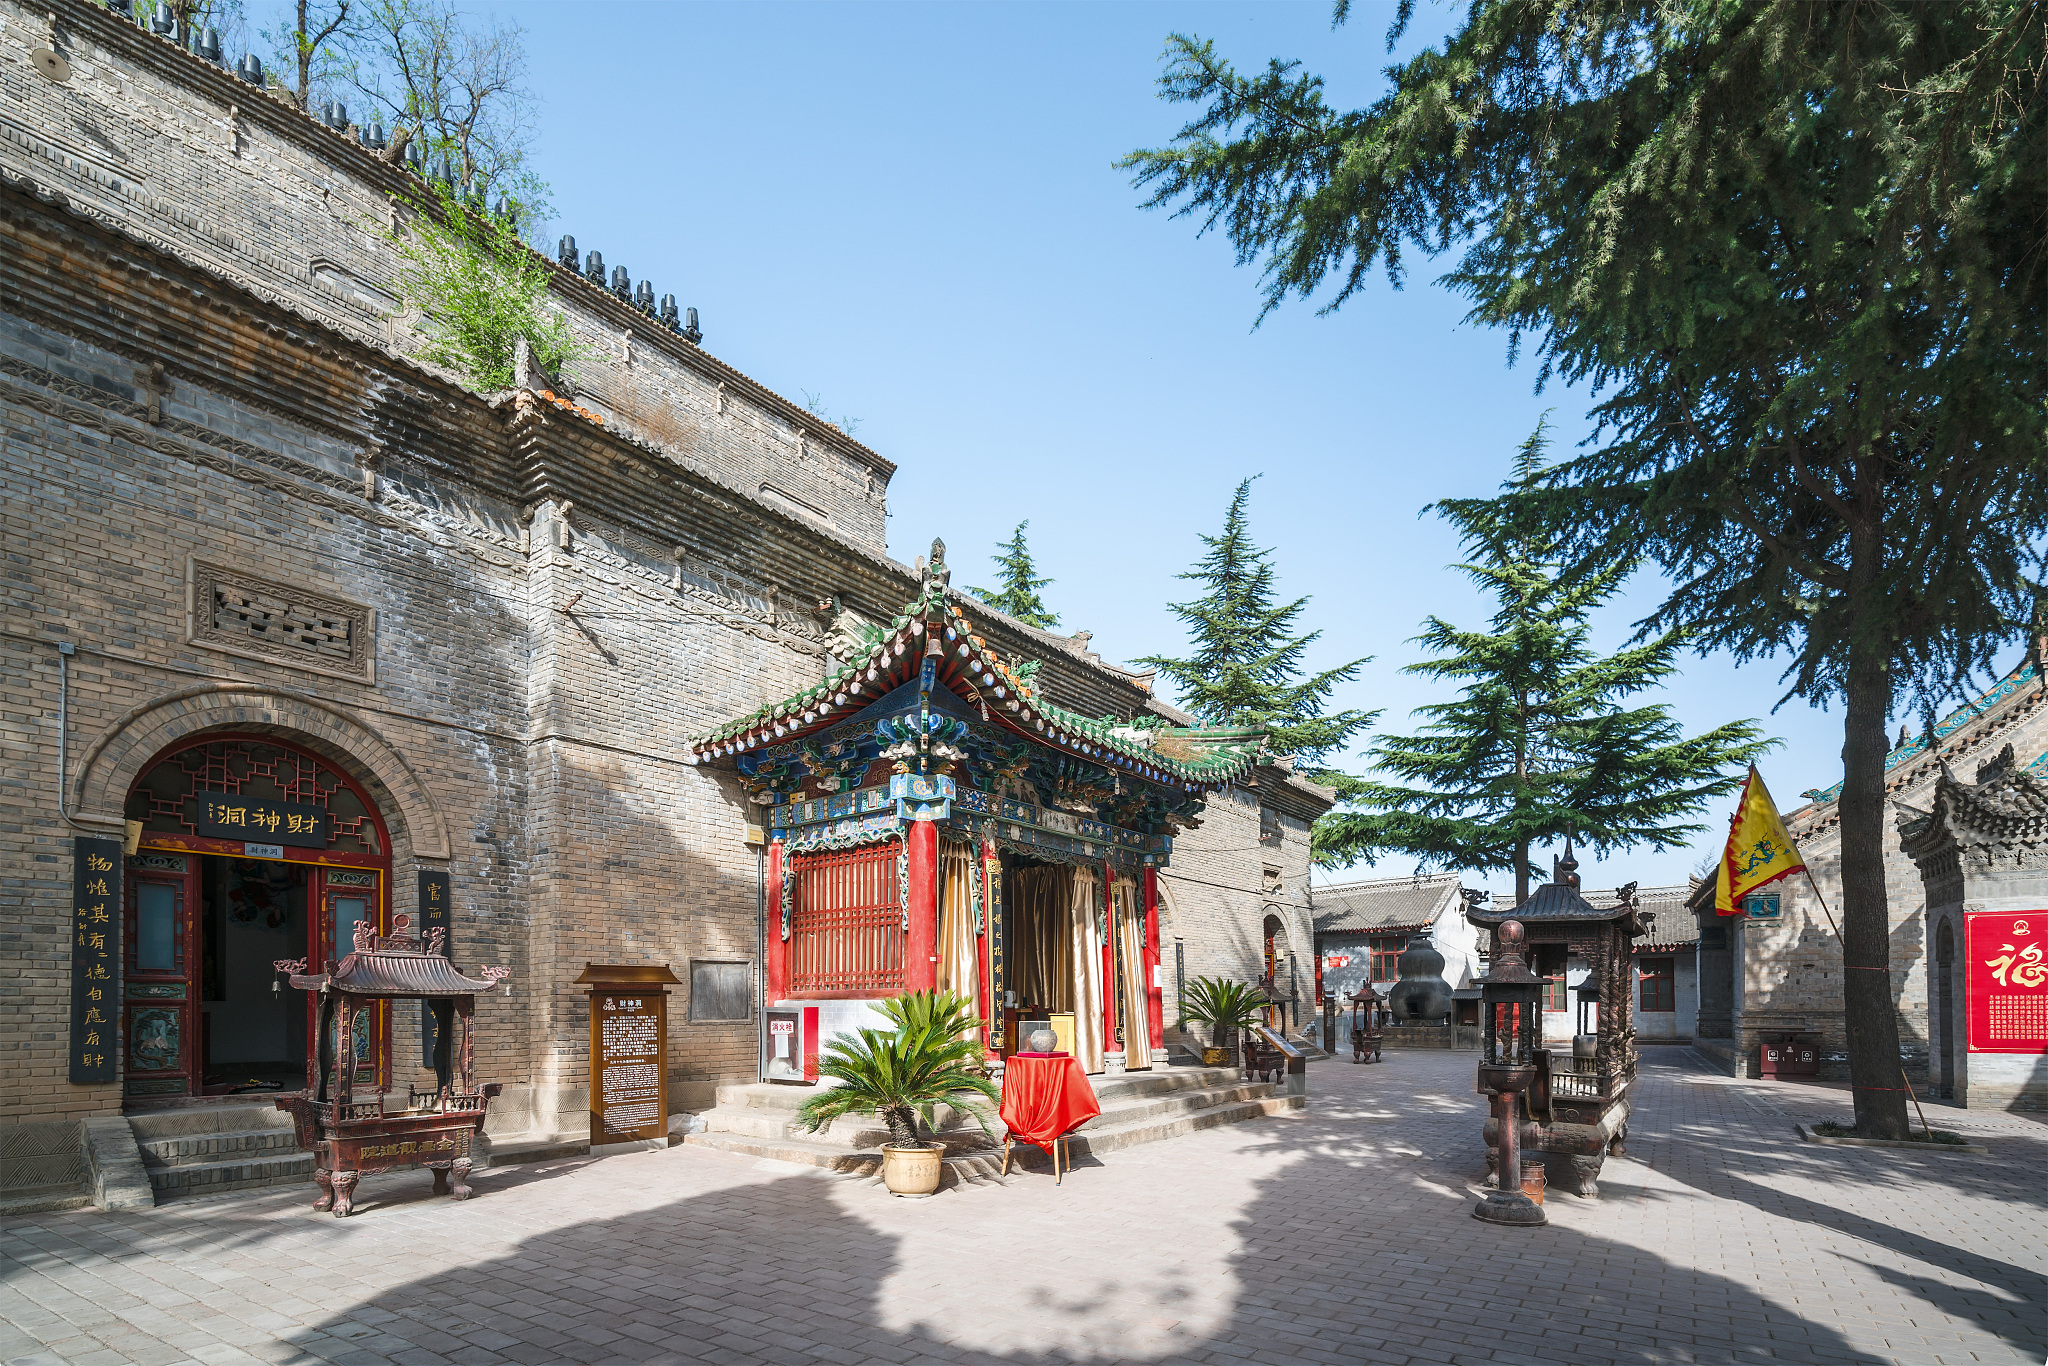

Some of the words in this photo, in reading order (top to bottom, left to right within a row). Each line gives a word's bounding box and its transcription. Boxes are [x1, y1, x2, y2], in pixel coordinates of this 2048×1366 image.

[1984, 941, 2048, 988] 福
[771, 1022, 793, 1032] 消火栓
